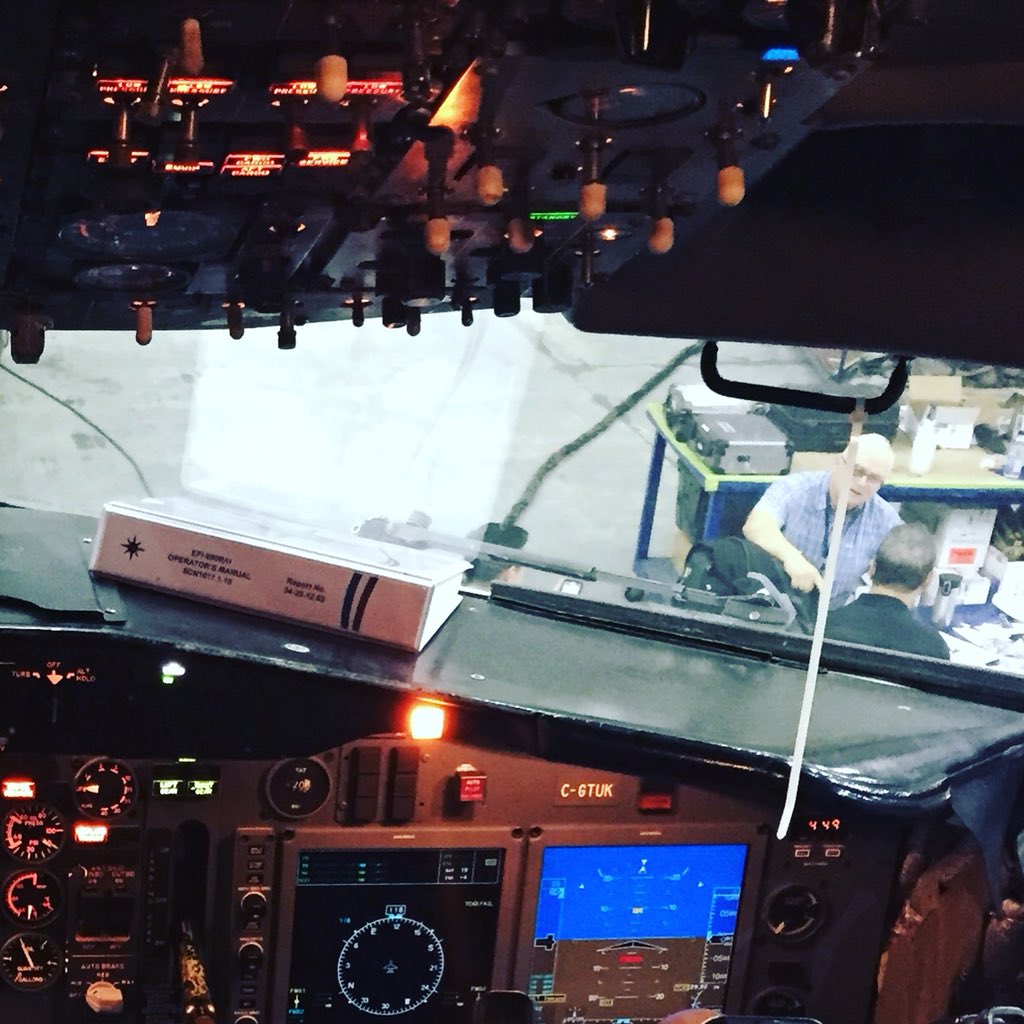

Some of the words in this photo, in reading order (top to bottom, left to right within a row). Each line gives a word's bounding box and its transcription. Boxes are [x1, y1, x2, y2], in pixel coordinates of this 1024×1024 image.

[168, 553, 217, 572] OPERATOR'S
[218, 566, 252, 581] MANUAL
[560, 782, 614, 798] C-GTUK
